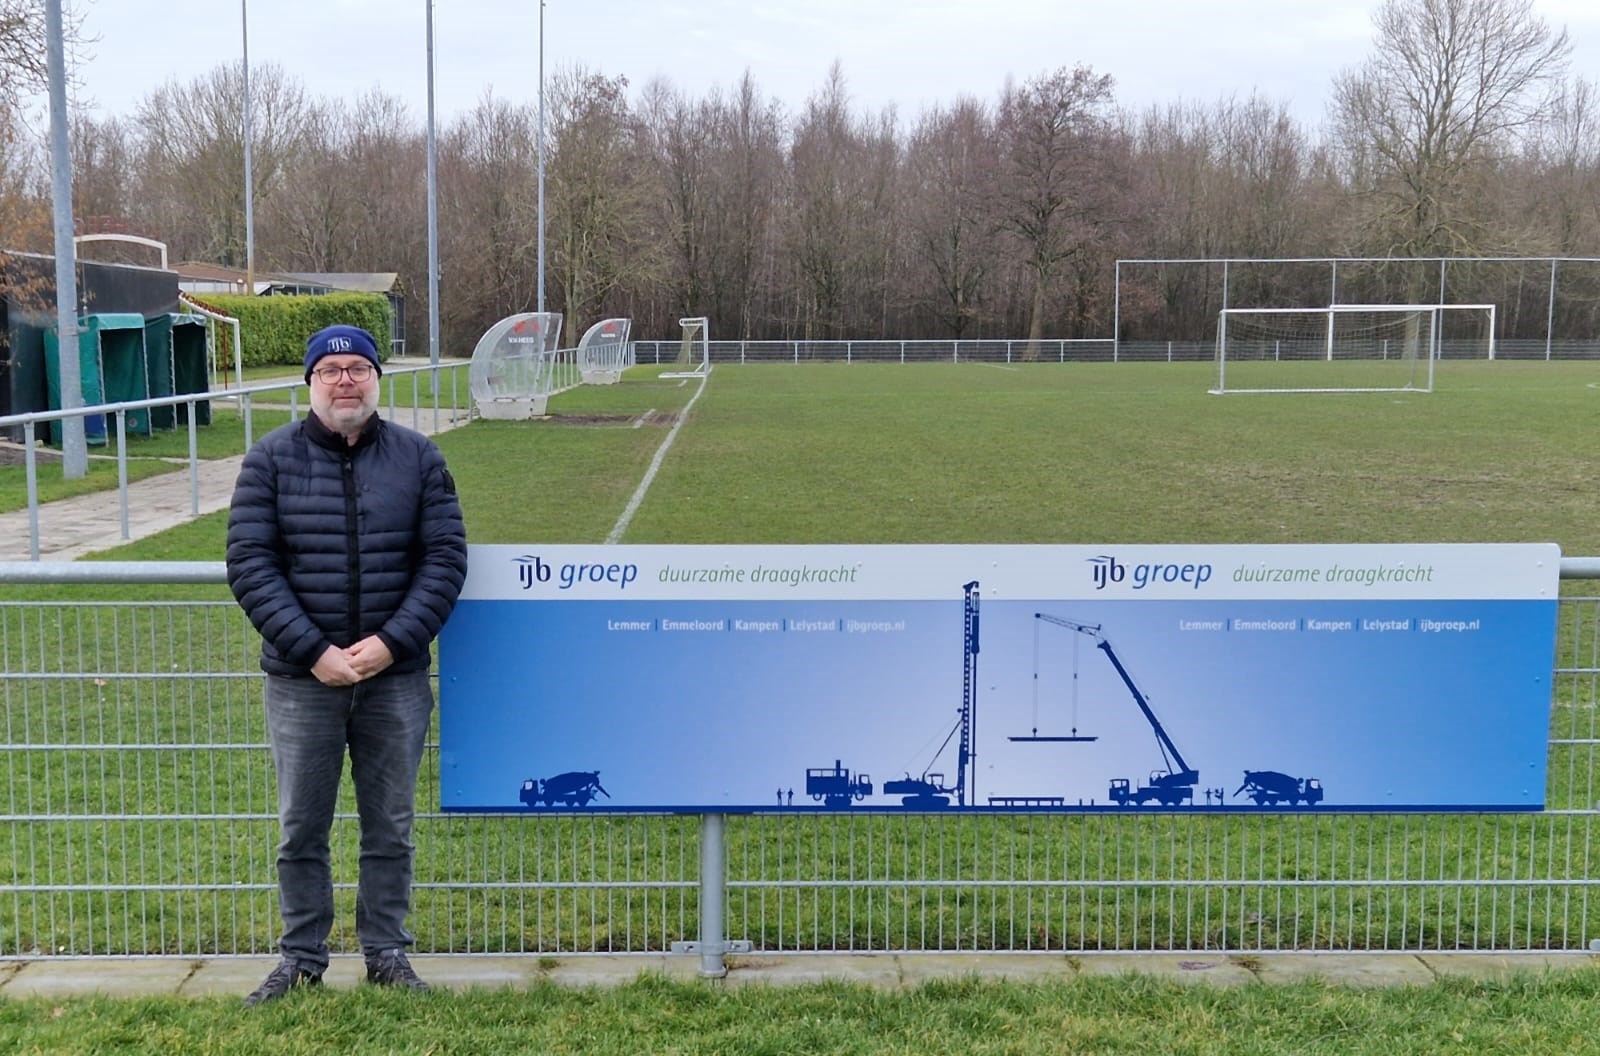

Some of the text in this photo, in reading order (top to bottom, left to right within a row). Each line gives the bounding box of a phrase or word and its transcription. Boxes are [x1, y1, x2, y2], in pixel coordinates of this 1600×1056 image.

[511, 554, 638, 590] ijb groep
[658, 564, 858, 587] duurzame draagkracht
[1085, 555, 1212, 590] ijb groep
[1232, 564, 1434, 587] duurzame draagkracht
[607, 619, 906, 635] Lemmer Emmeloord Kampen Lelystad ijbgroep.nl
[1179, 619, 1480, 633] Lemmer Emmeloord Kampen Lelystad ijbgroep.nl
